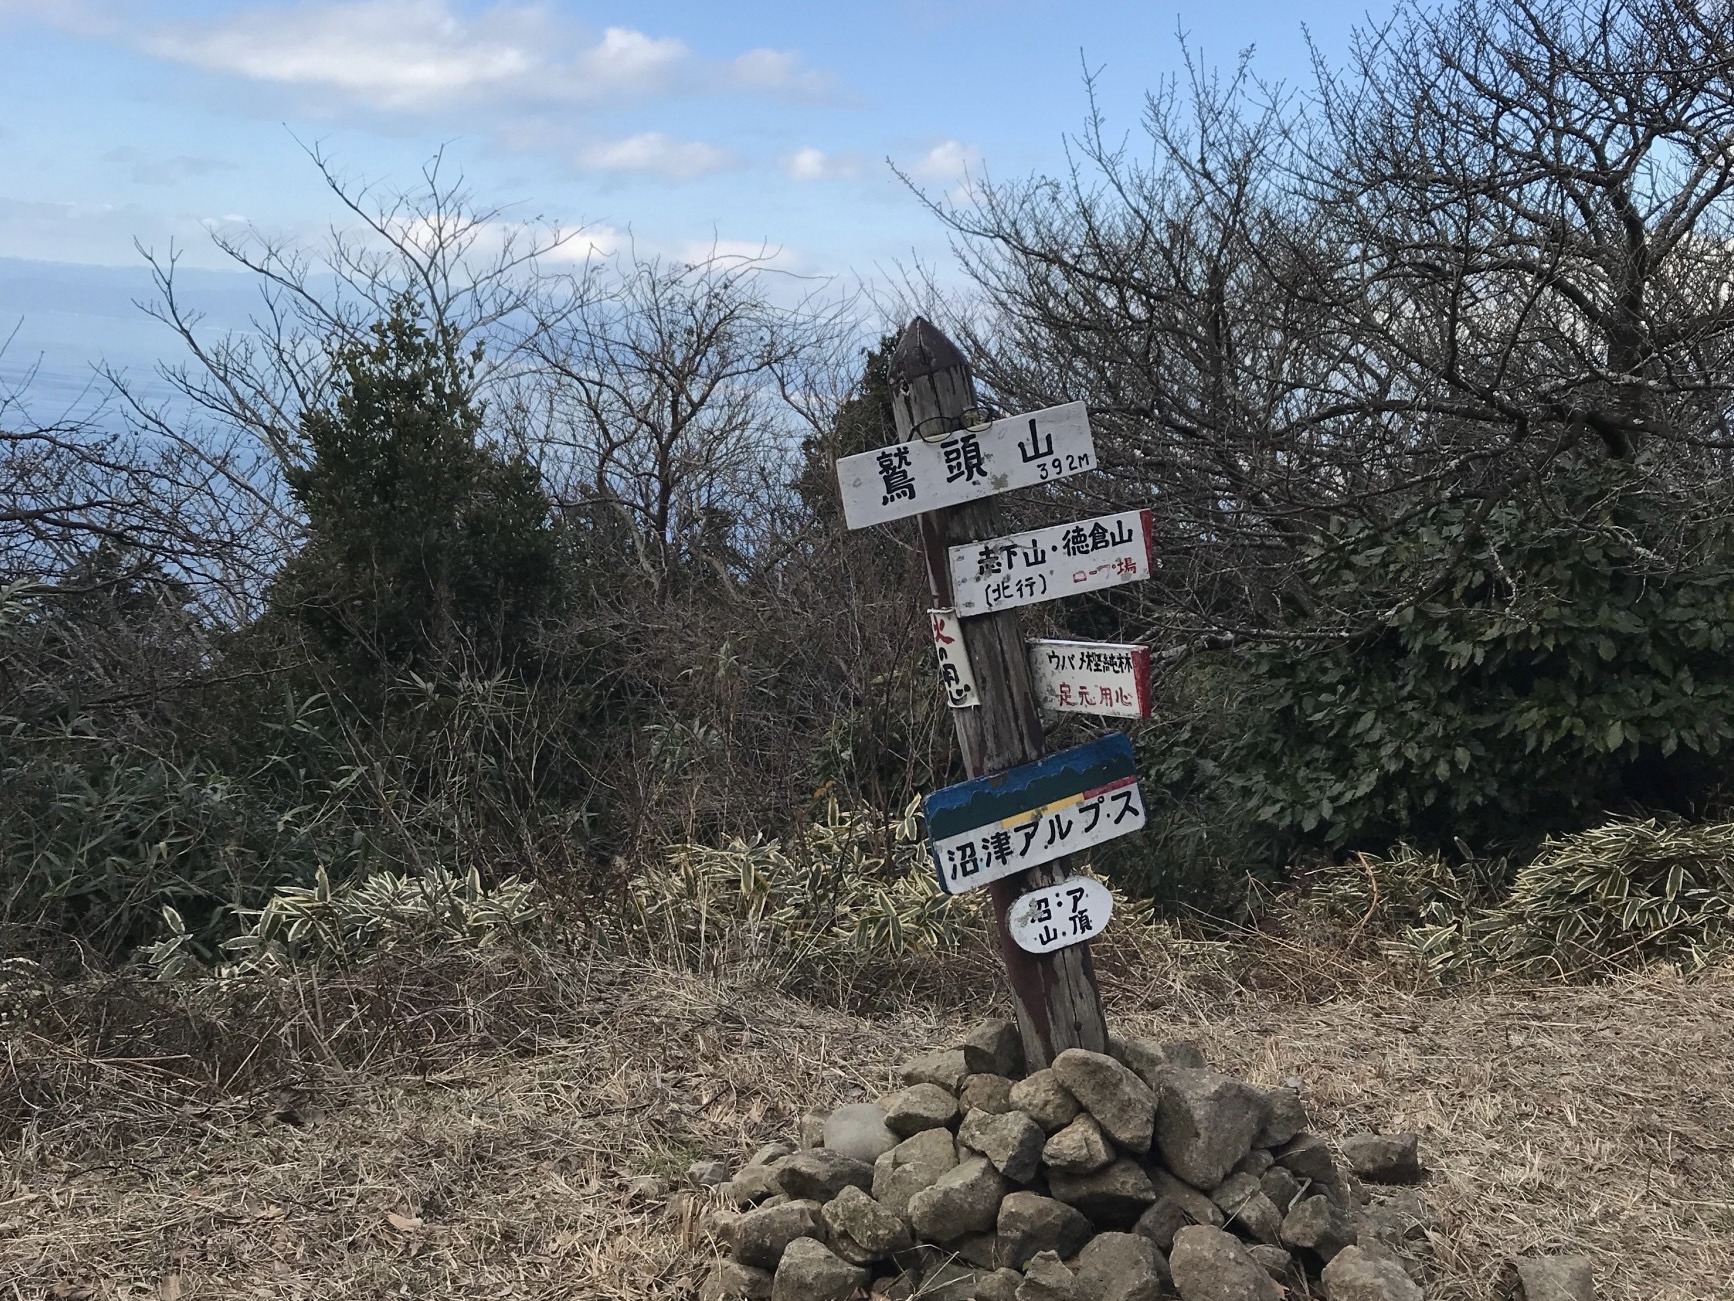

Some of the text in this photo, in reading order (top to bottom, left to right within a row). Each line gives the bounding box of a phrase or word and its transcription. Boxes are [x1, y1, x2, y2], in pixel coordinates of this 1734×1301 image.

[877, 419, 1053, 505] 鷲頭山
[1037, 454, 1090, 480] 392M
